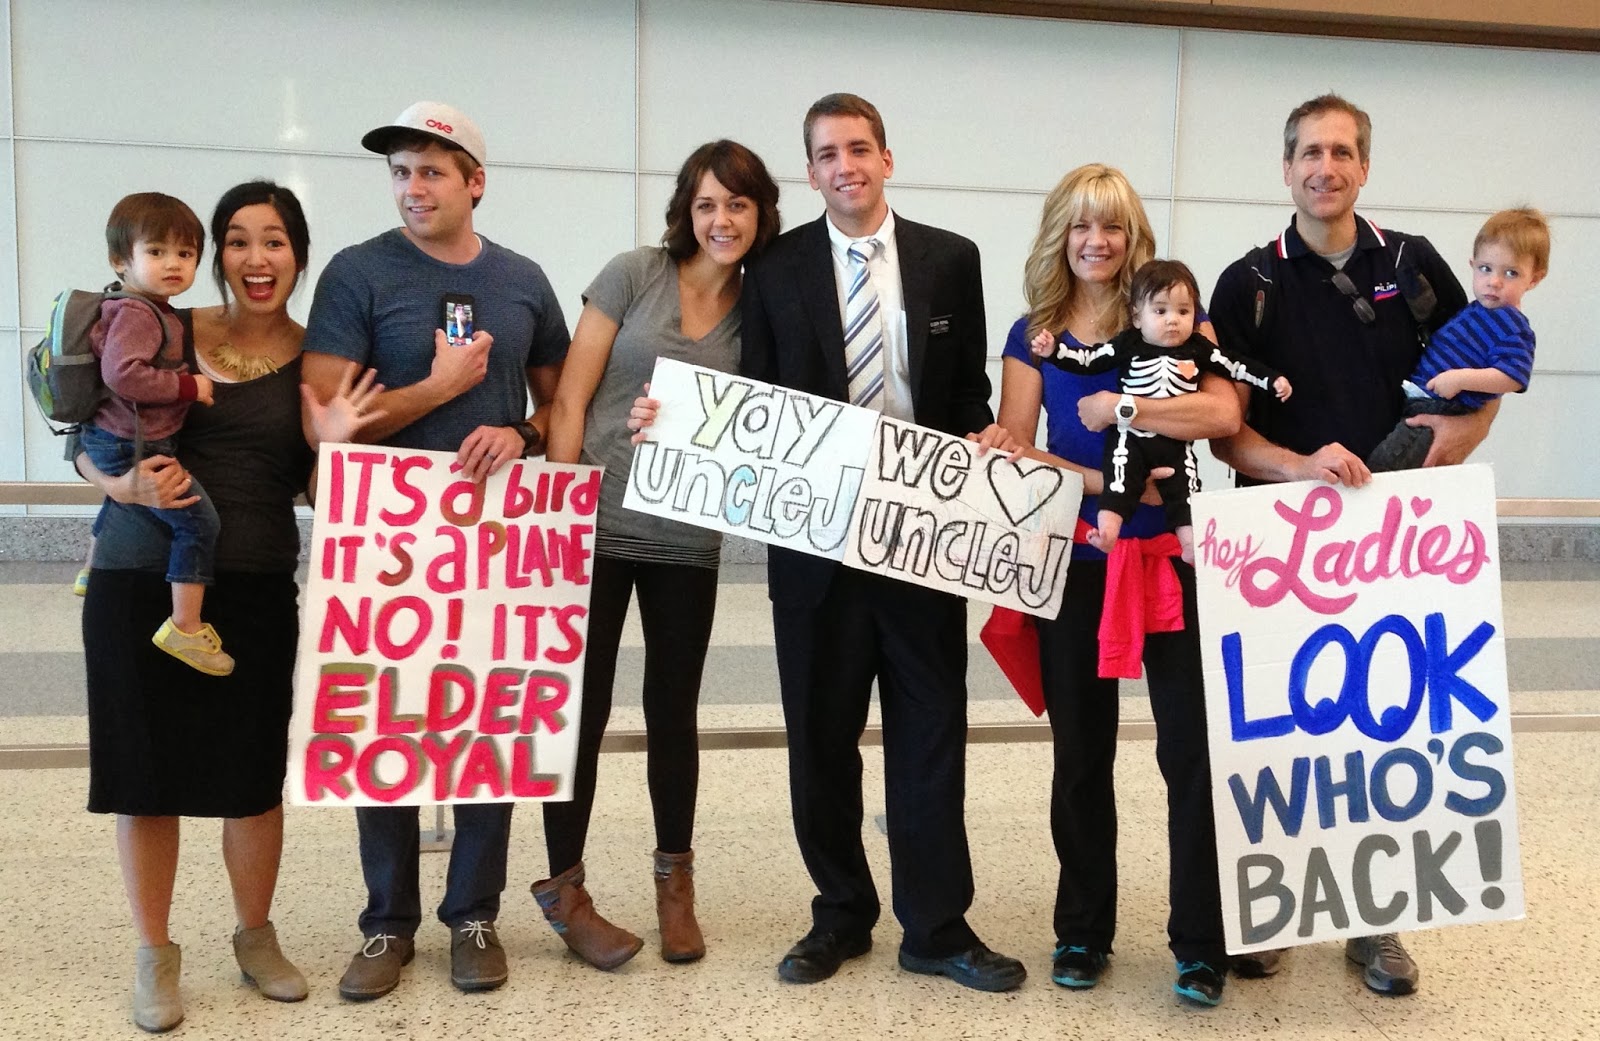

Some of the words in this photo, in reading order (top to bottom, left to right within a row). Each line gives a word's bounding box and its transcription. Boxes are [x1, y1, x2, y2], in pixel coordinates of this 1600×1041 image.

[328, 450, 433, 526] IT'S
[503, 463, 601, 518] bird
[321, 532, 417, 586] IT'S
[426, 525, 467, 594] a
[1198, 518, 1264, 588] hey
[1239, 486, 1490, 615] Ladies
[318, 595, 464, 660] NO!
[311, 662, 570, 735] ELDER
[1221, 612, 1499, 742] LOOK
[304, 729, 560, 803] ROYAL
[1228, 732, 1507, 845] WHO'S
[1236, 819, 1506, 945] BACK!
